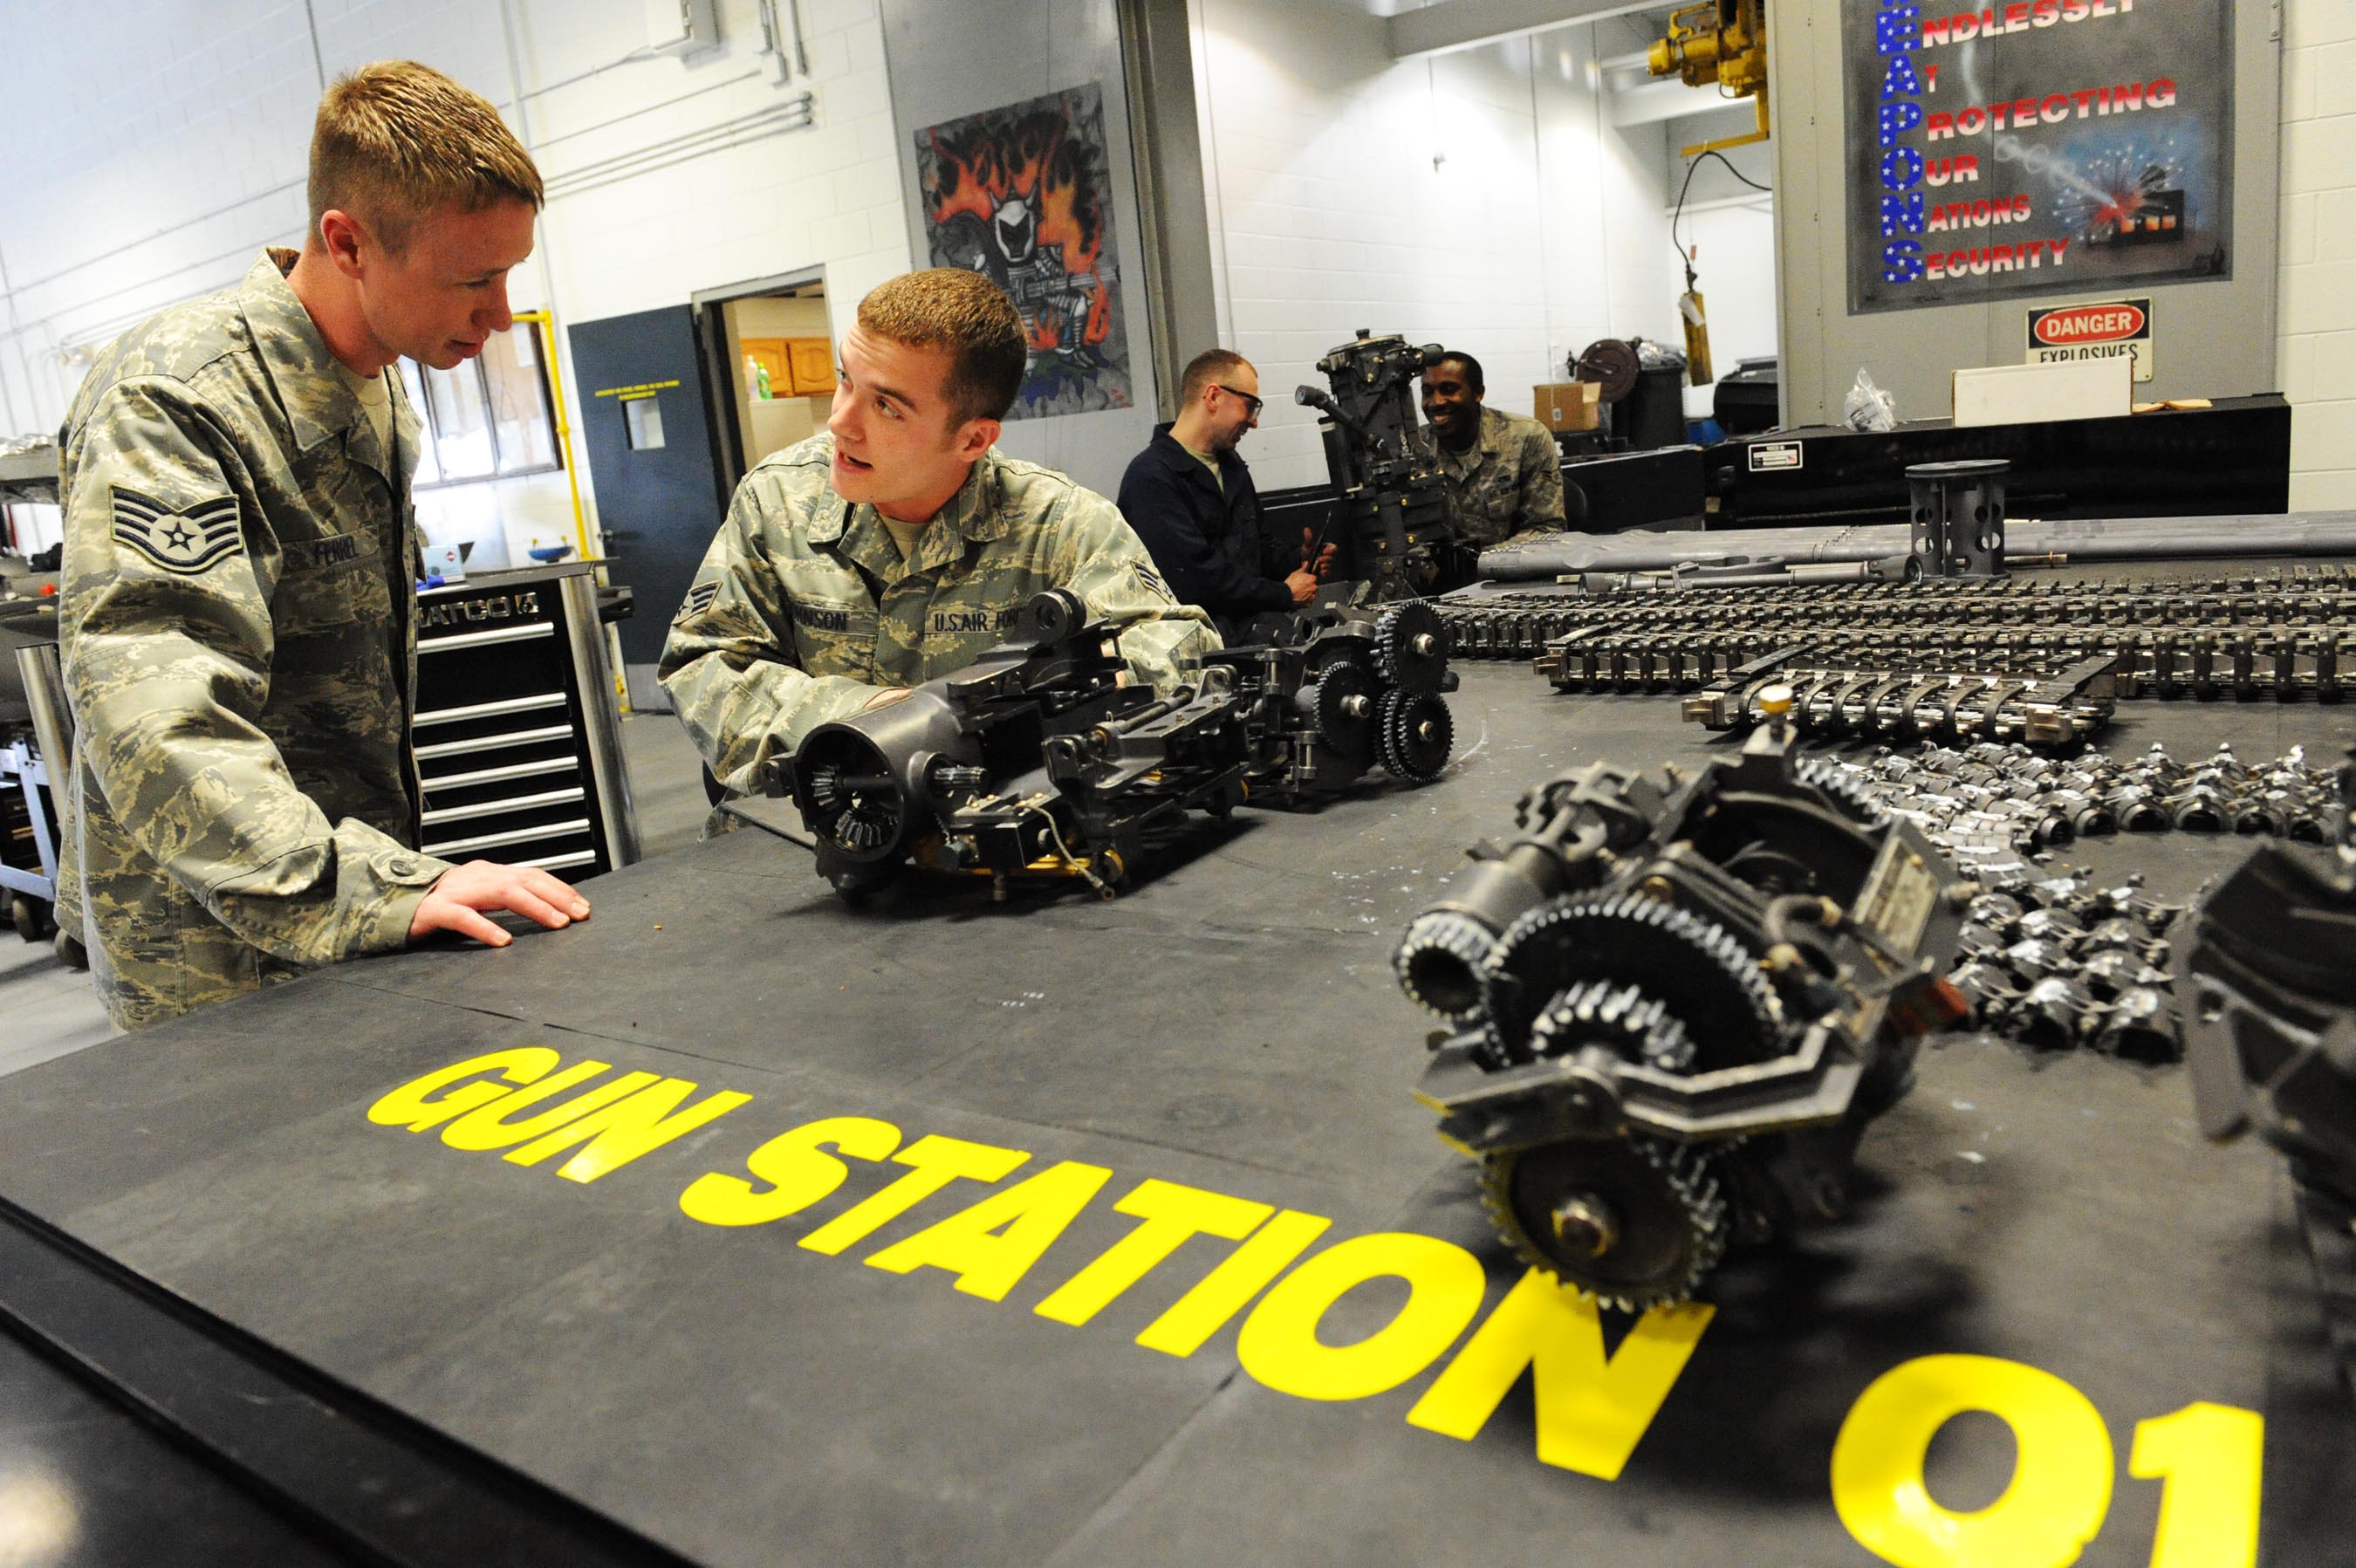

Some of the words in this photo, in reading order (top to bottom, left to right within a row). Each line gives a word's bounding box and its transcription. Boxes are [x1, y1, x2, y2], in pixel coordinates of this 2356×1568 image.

[2046, 312, 2133, 338] DANGER
[367, 1047, 752, 1185] GUN
[680, 1116, 1716, 1481] STATION
